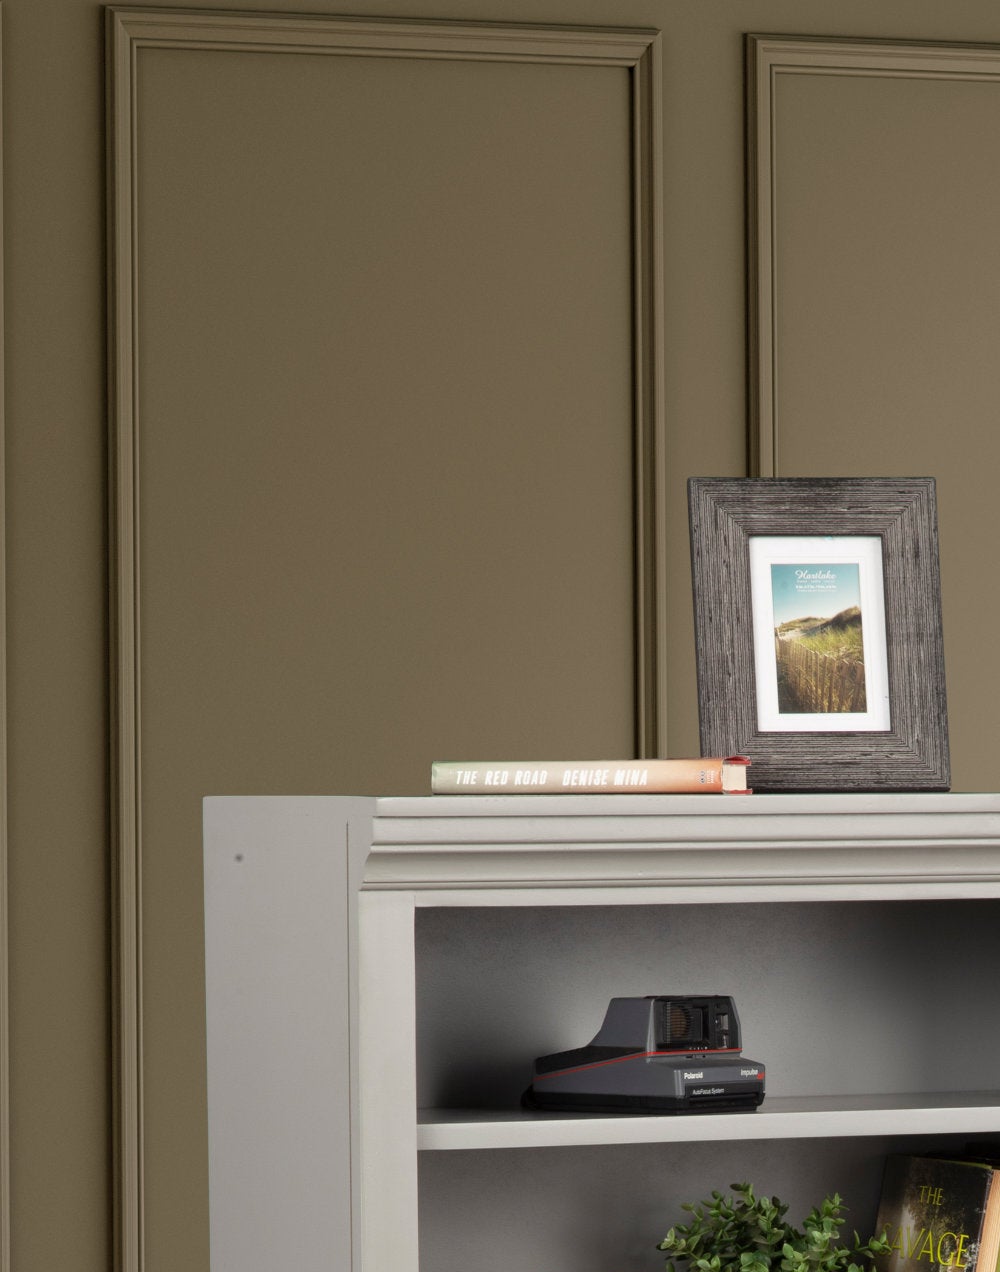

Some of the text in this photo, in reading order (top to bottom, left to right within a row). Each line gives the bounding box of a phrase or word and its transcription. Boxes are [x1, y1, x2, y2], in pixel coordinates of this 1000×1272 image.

[456, 769, 649, 786] THE RED ROAD DENISE MINA
[920, 1185, 944, 1206] THE
[879, 1222, 970, 1268] SAVAGE
